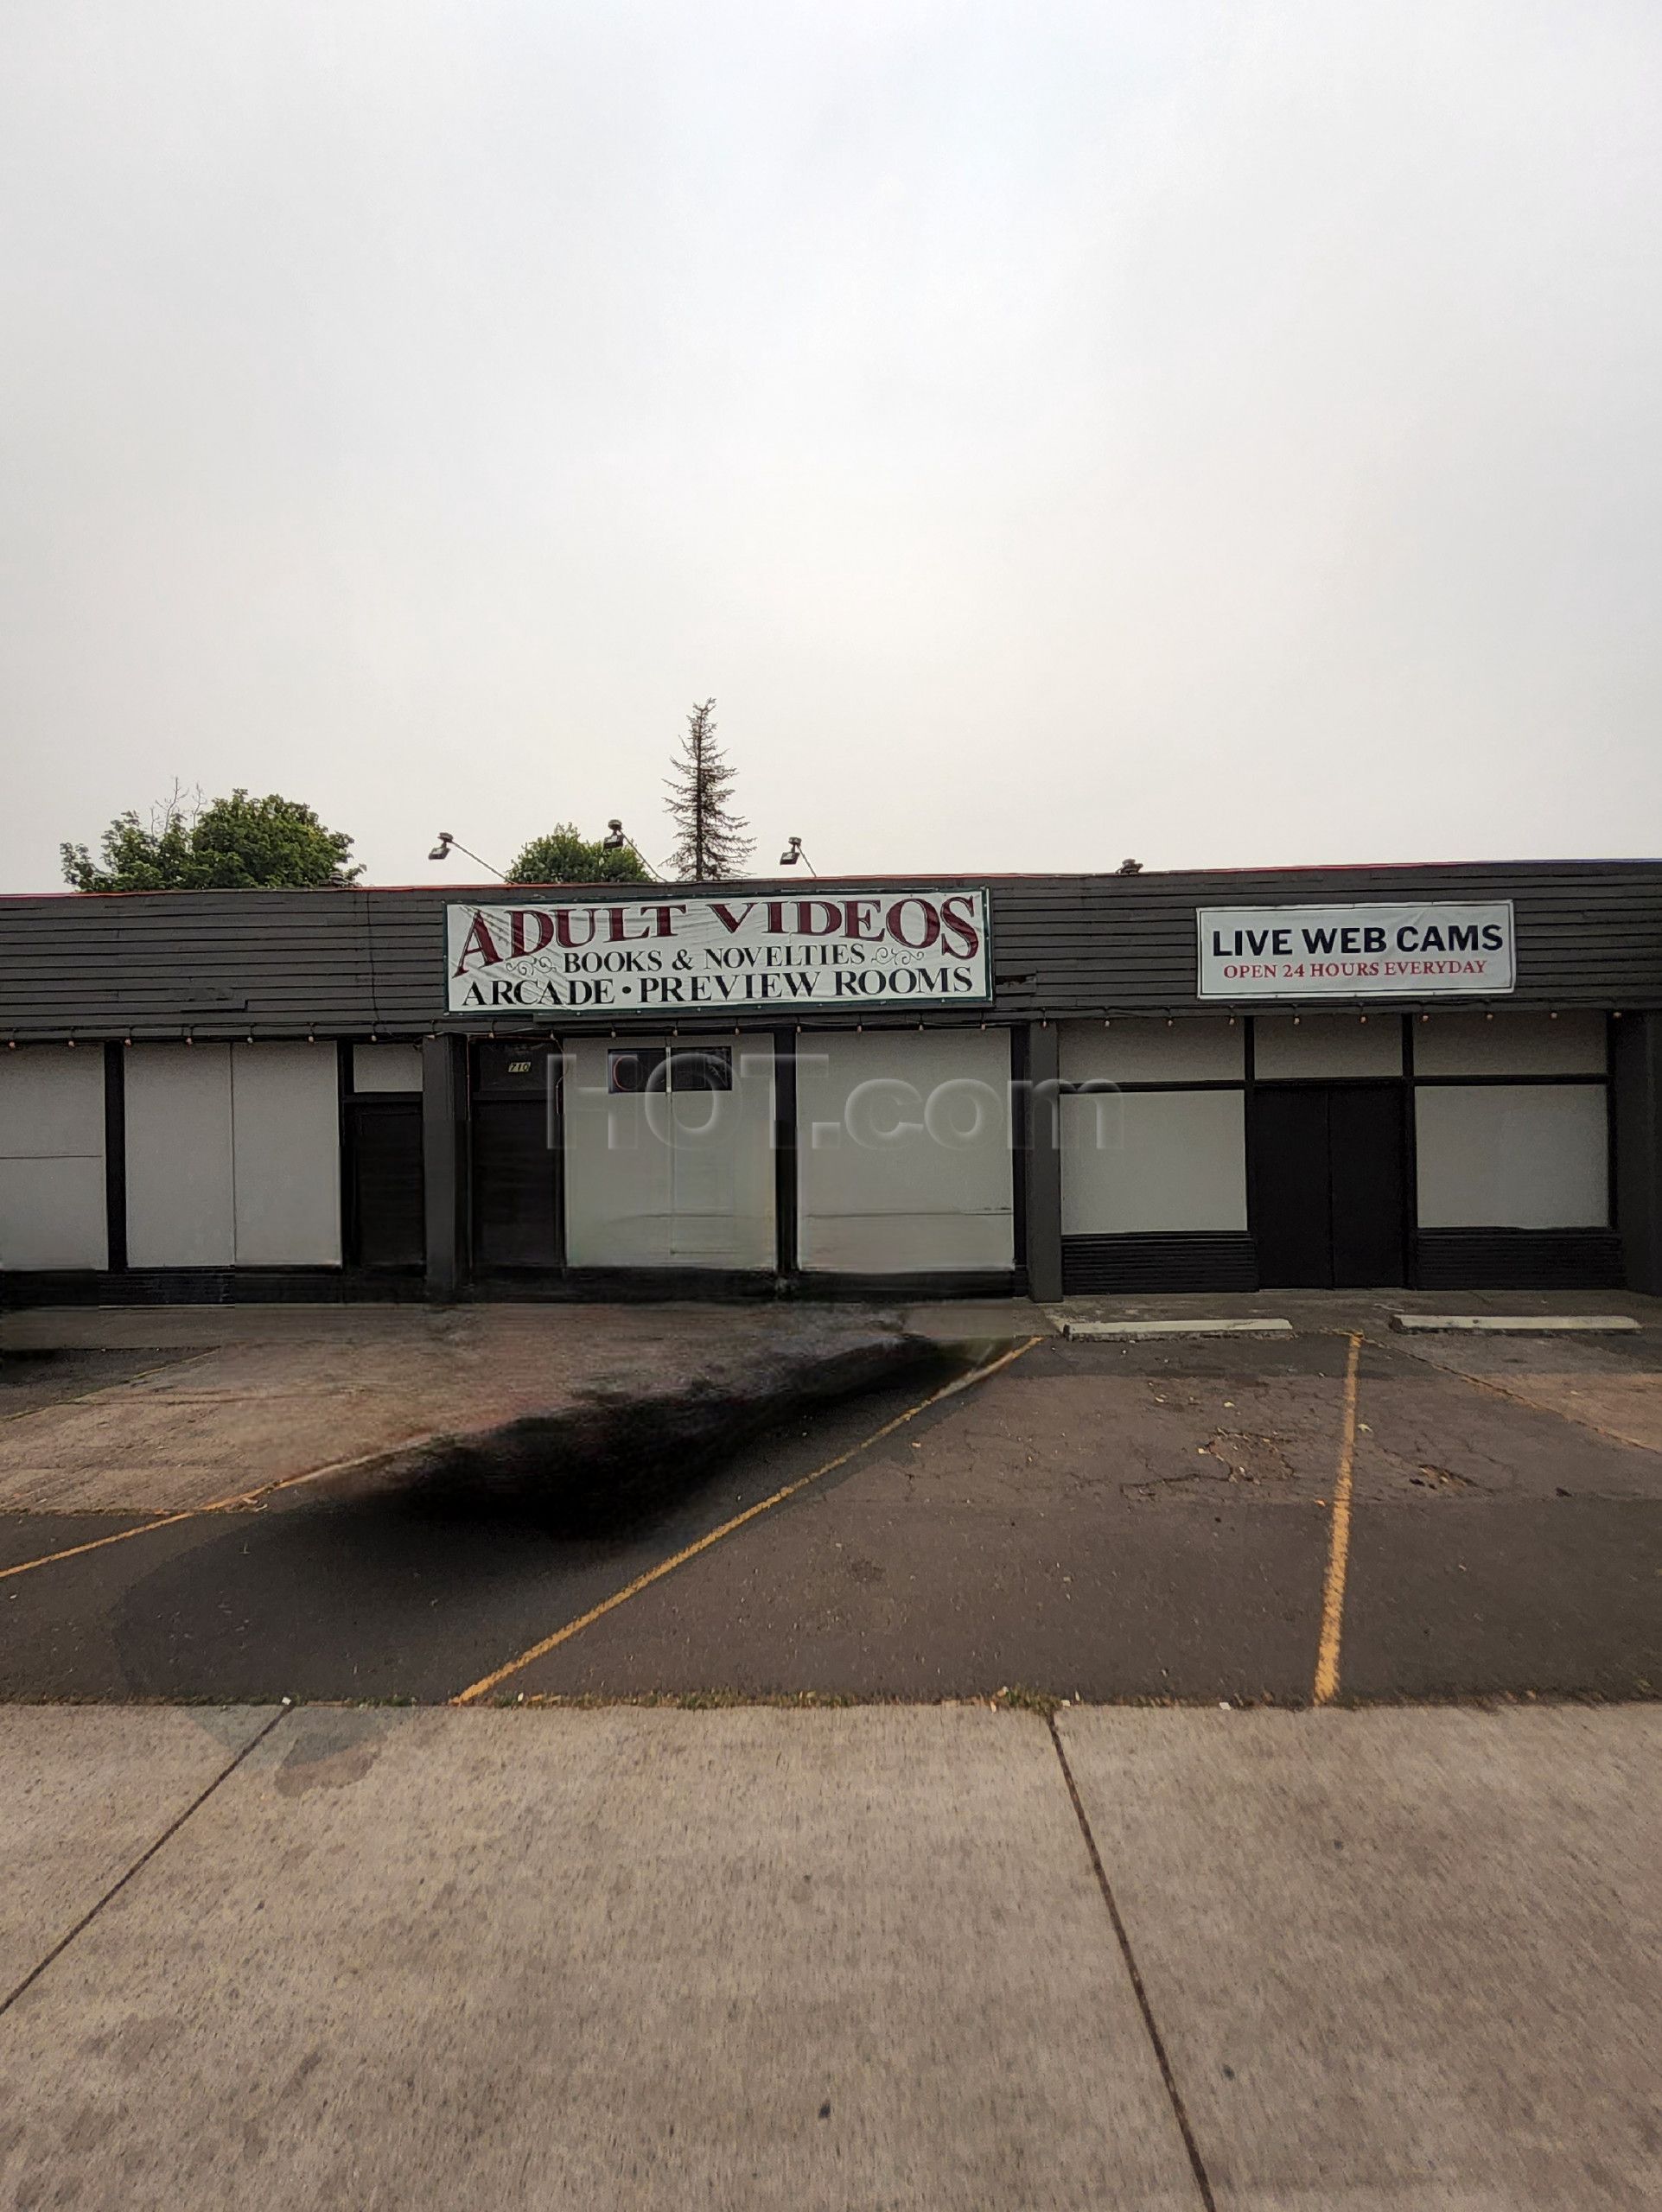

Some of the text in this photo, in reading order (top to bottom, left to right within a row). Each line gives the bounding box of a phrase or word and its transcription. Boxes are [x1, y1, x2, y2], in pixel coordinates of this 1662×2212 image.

[452, 895, 979, 978] ADULT VIDEOS
[1213, 924, 1504, 956] LIVE WEB CAMS
[564, 944, 865, 974] BOOKS & NOVELTIES
[1223, 959, 1488, 979] OPEN 24 HOURS EVERYDAY
[462, 966, 973, 1007] ARCADE PREVIEW ROOMS
